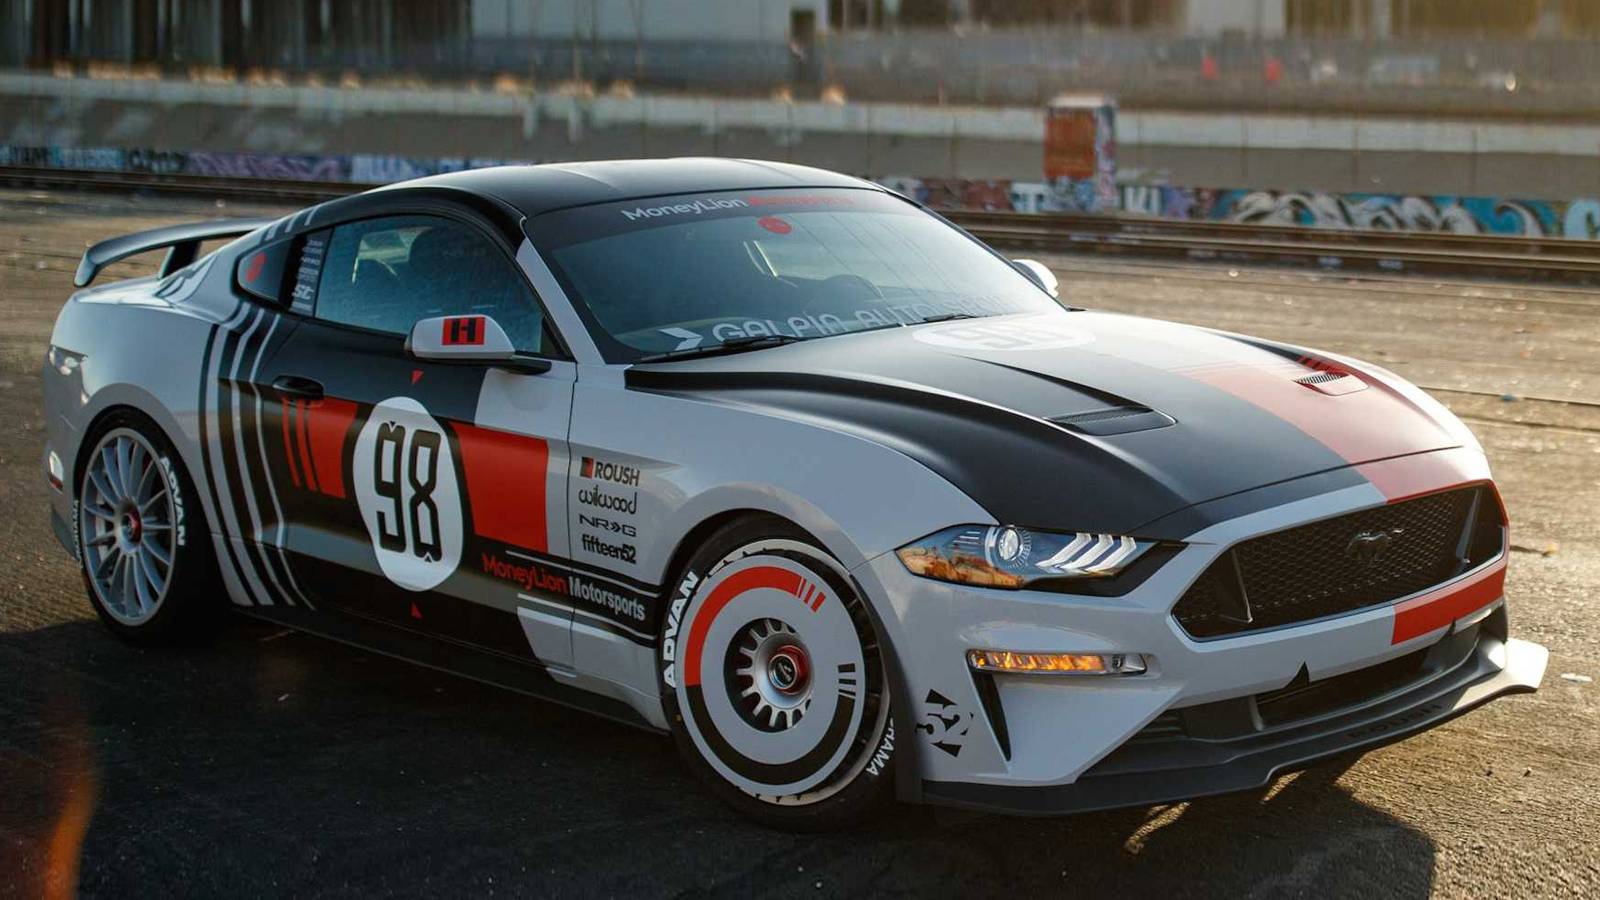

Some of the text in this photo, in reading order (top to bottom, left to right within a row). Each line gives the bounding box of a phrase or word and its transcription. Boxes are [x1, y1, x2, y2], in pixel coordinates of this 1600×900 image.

[621, 196, 749, 221] MoneyLion
[450, 317, 477, 343] H
[594, 461, 640, 487] ROUSH
[160, 456, 186, 546] ADVAN
[374, 421, 443, 562] 98
[578, 485, 637, 515] wilwood
[581, 533, 637, 565] fifteen52
[481, 553, 647, 622] MoneyLion Motorsports
[663, 571, 699, 688] ADVAN
